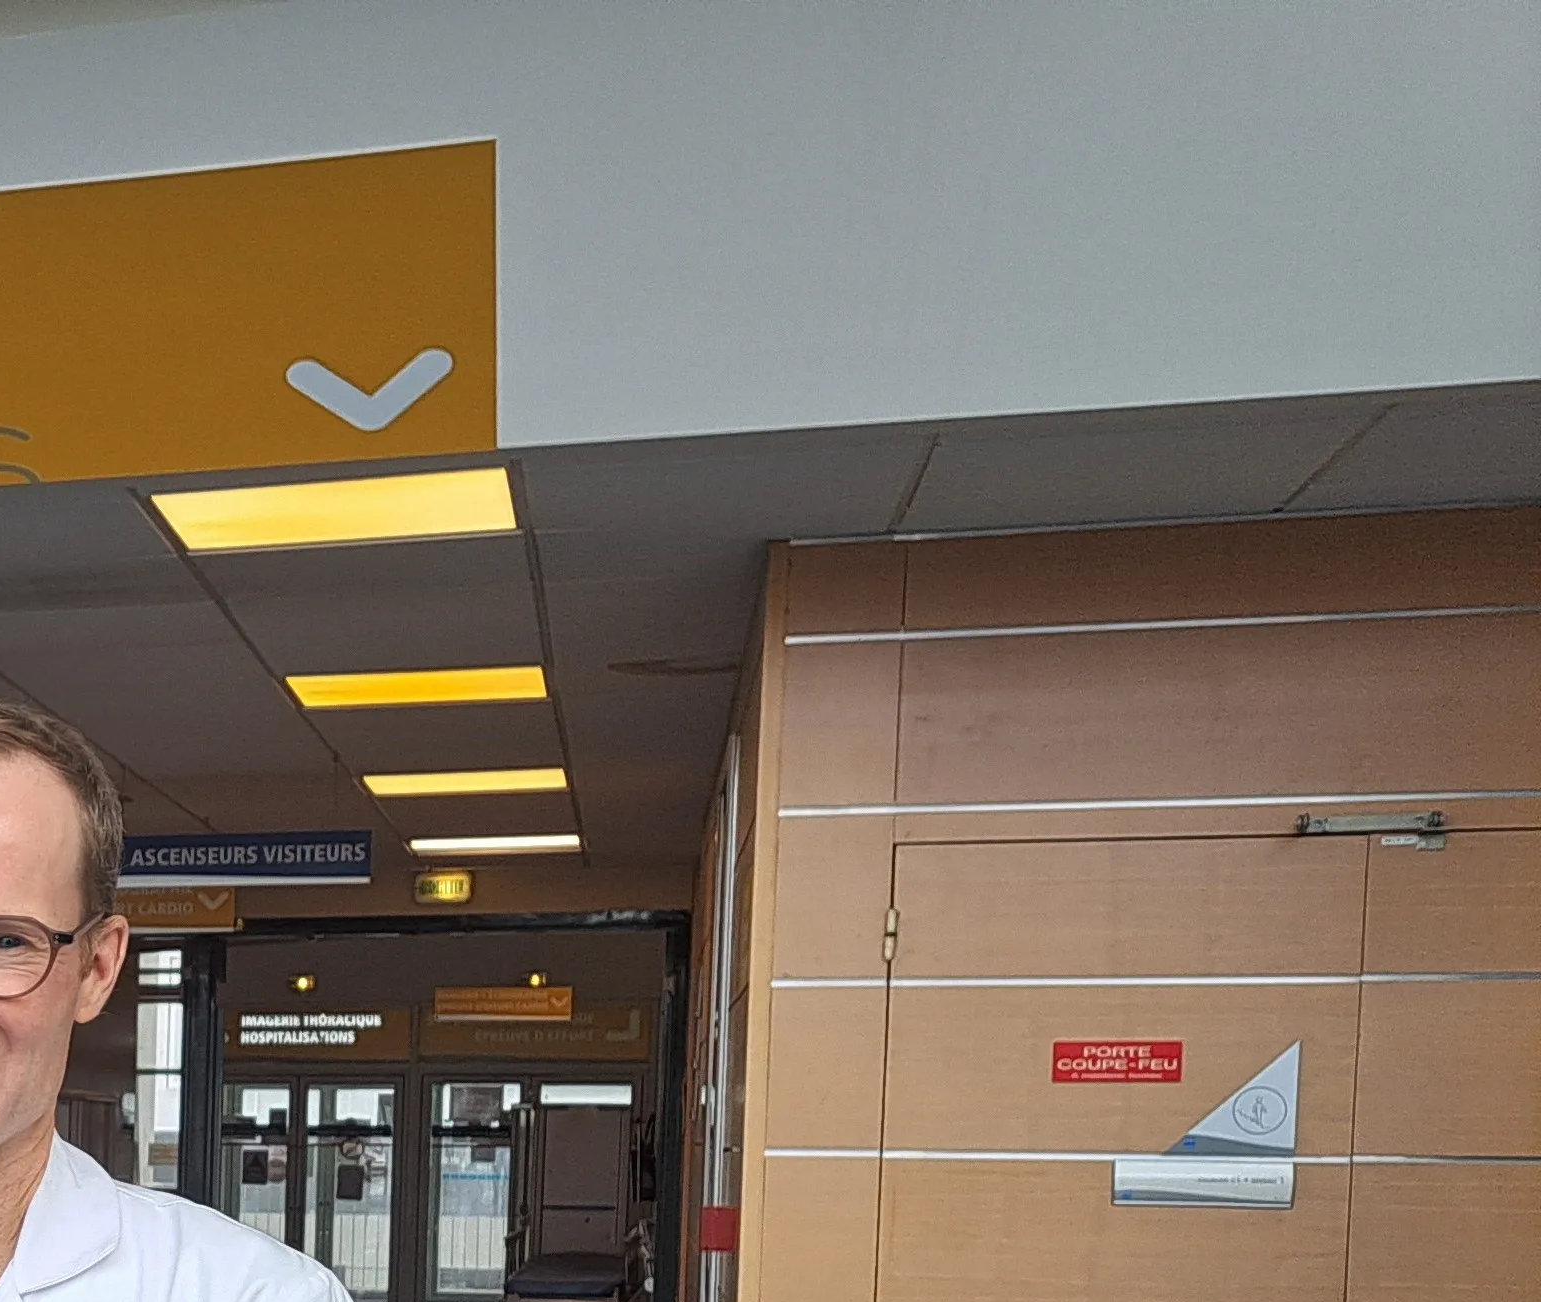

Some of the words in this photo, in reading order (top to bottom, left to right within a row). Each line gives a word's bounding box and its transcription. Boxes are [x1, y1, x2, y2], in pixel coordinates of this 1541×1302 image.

[130, 845, 258, 867] ASCENSEURS
[263, 842, 366, 864] VISITEURS
[241, 1014, 301, 1028] IMAGERIE
[240, 1030, 356, 1045] HOSPITALISATIONS
[1083, 1045, 1152, 1057] PORTE
[1057, 1058, 1177, 1071] COUPE-FEU
